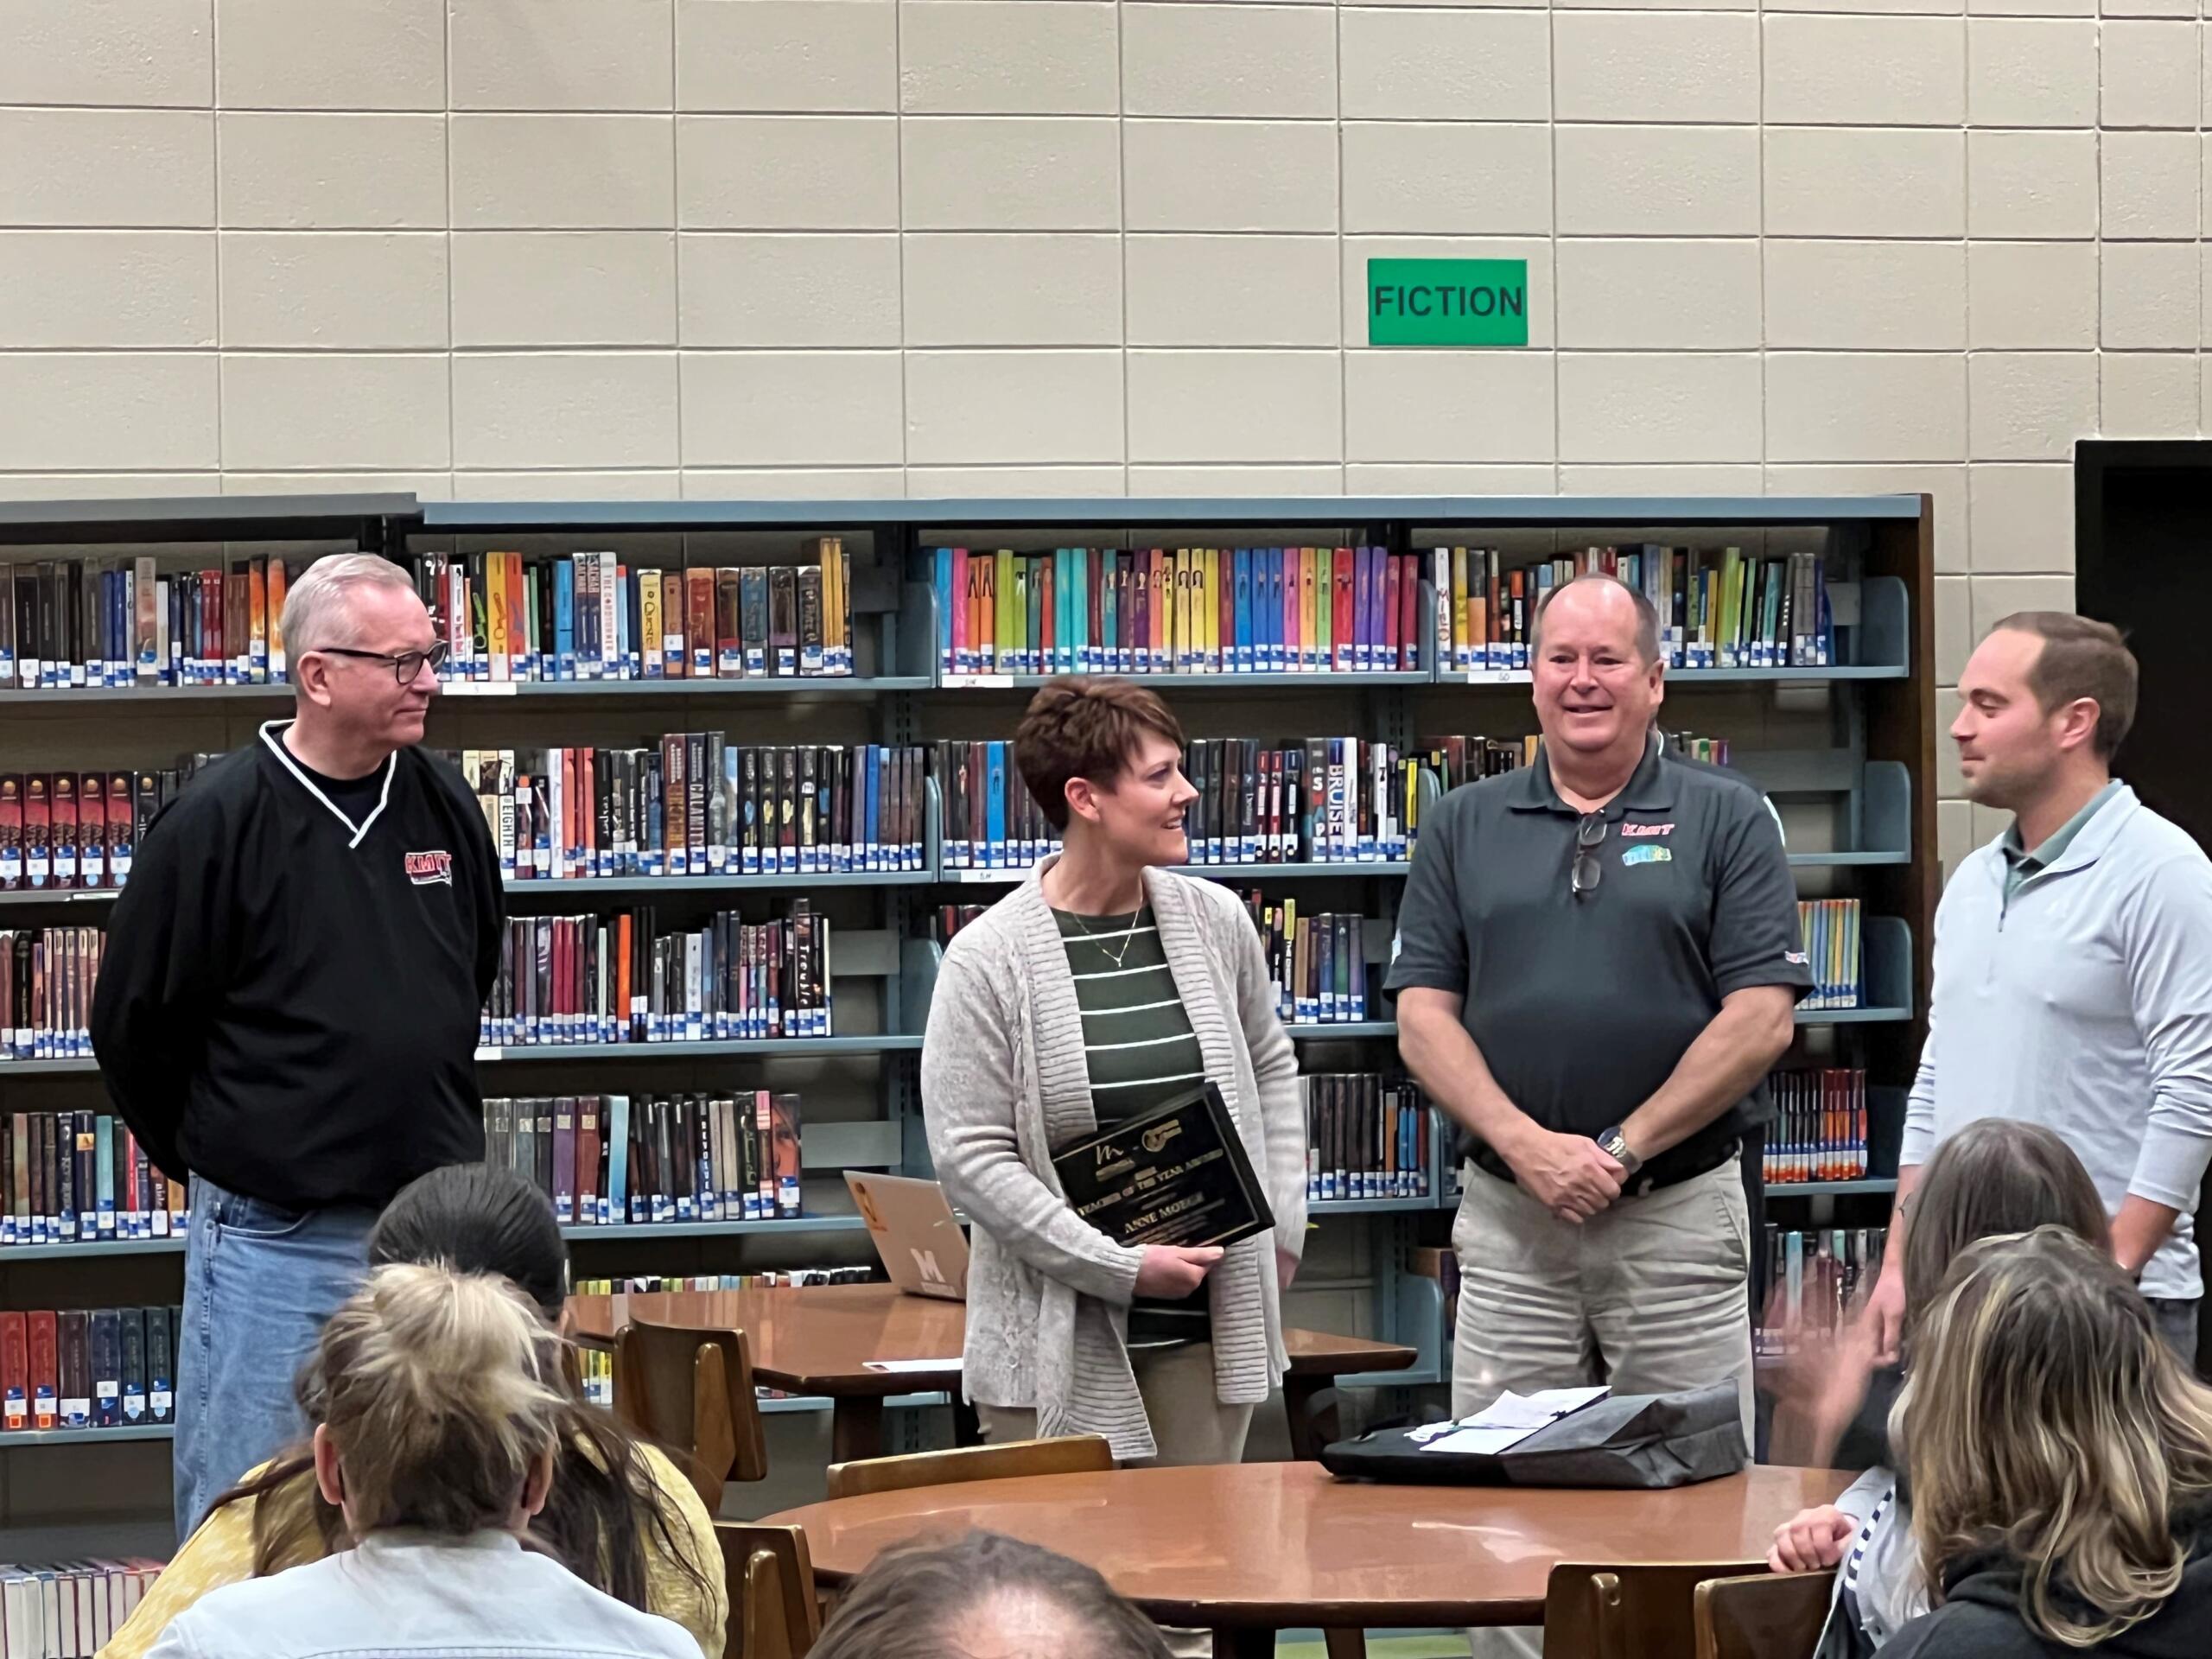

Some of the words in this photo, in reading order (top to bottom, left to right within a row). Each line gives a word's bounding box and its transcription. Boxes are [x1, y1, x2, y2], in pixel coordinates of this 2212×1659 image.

[1375, 285, 1522, 316] FICTION
[502, 804, 514, 847] EIGHTH
[690, 784, 704, 847] CALAMITY
[799, 945, 810, 1005] Trouble
[1124, 1211, 1159, 1235] ANNE
